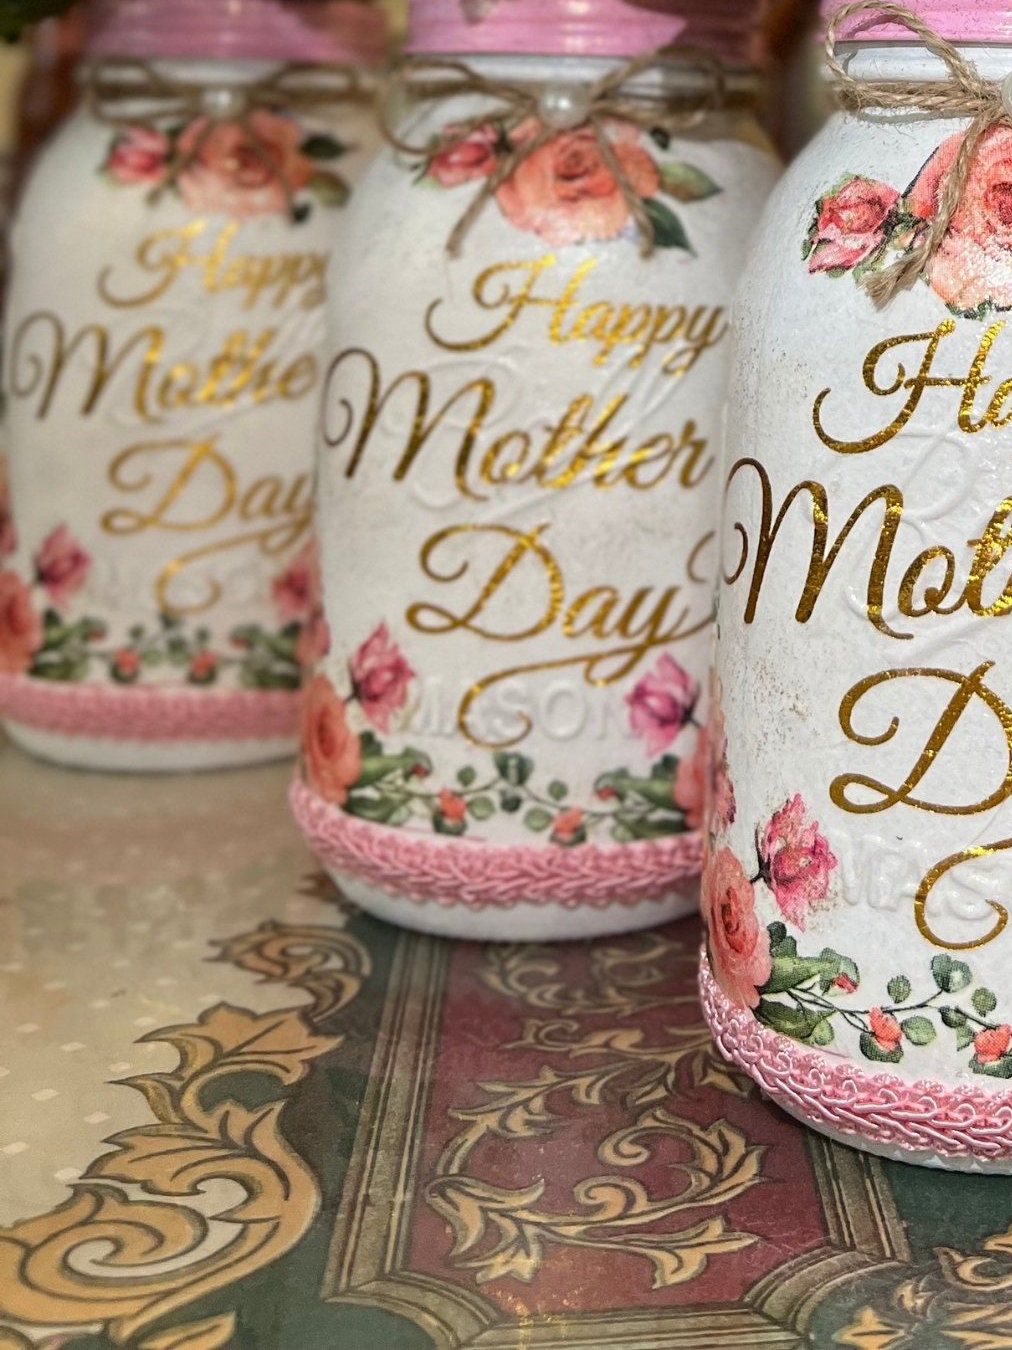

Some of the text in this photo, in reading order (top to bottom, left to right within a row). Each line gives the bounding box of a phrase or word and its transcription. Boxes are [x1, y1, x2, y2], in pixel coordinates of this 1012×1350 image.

[98, 218, 326, 310] Happy
[424, 254, 732, 378] Happy
[8, 310, 320, 425] Mothe
[321, 347, 716, 502] Mother
[100, 432, 320, 616] Day
[405, 522, 718, 748] Day
